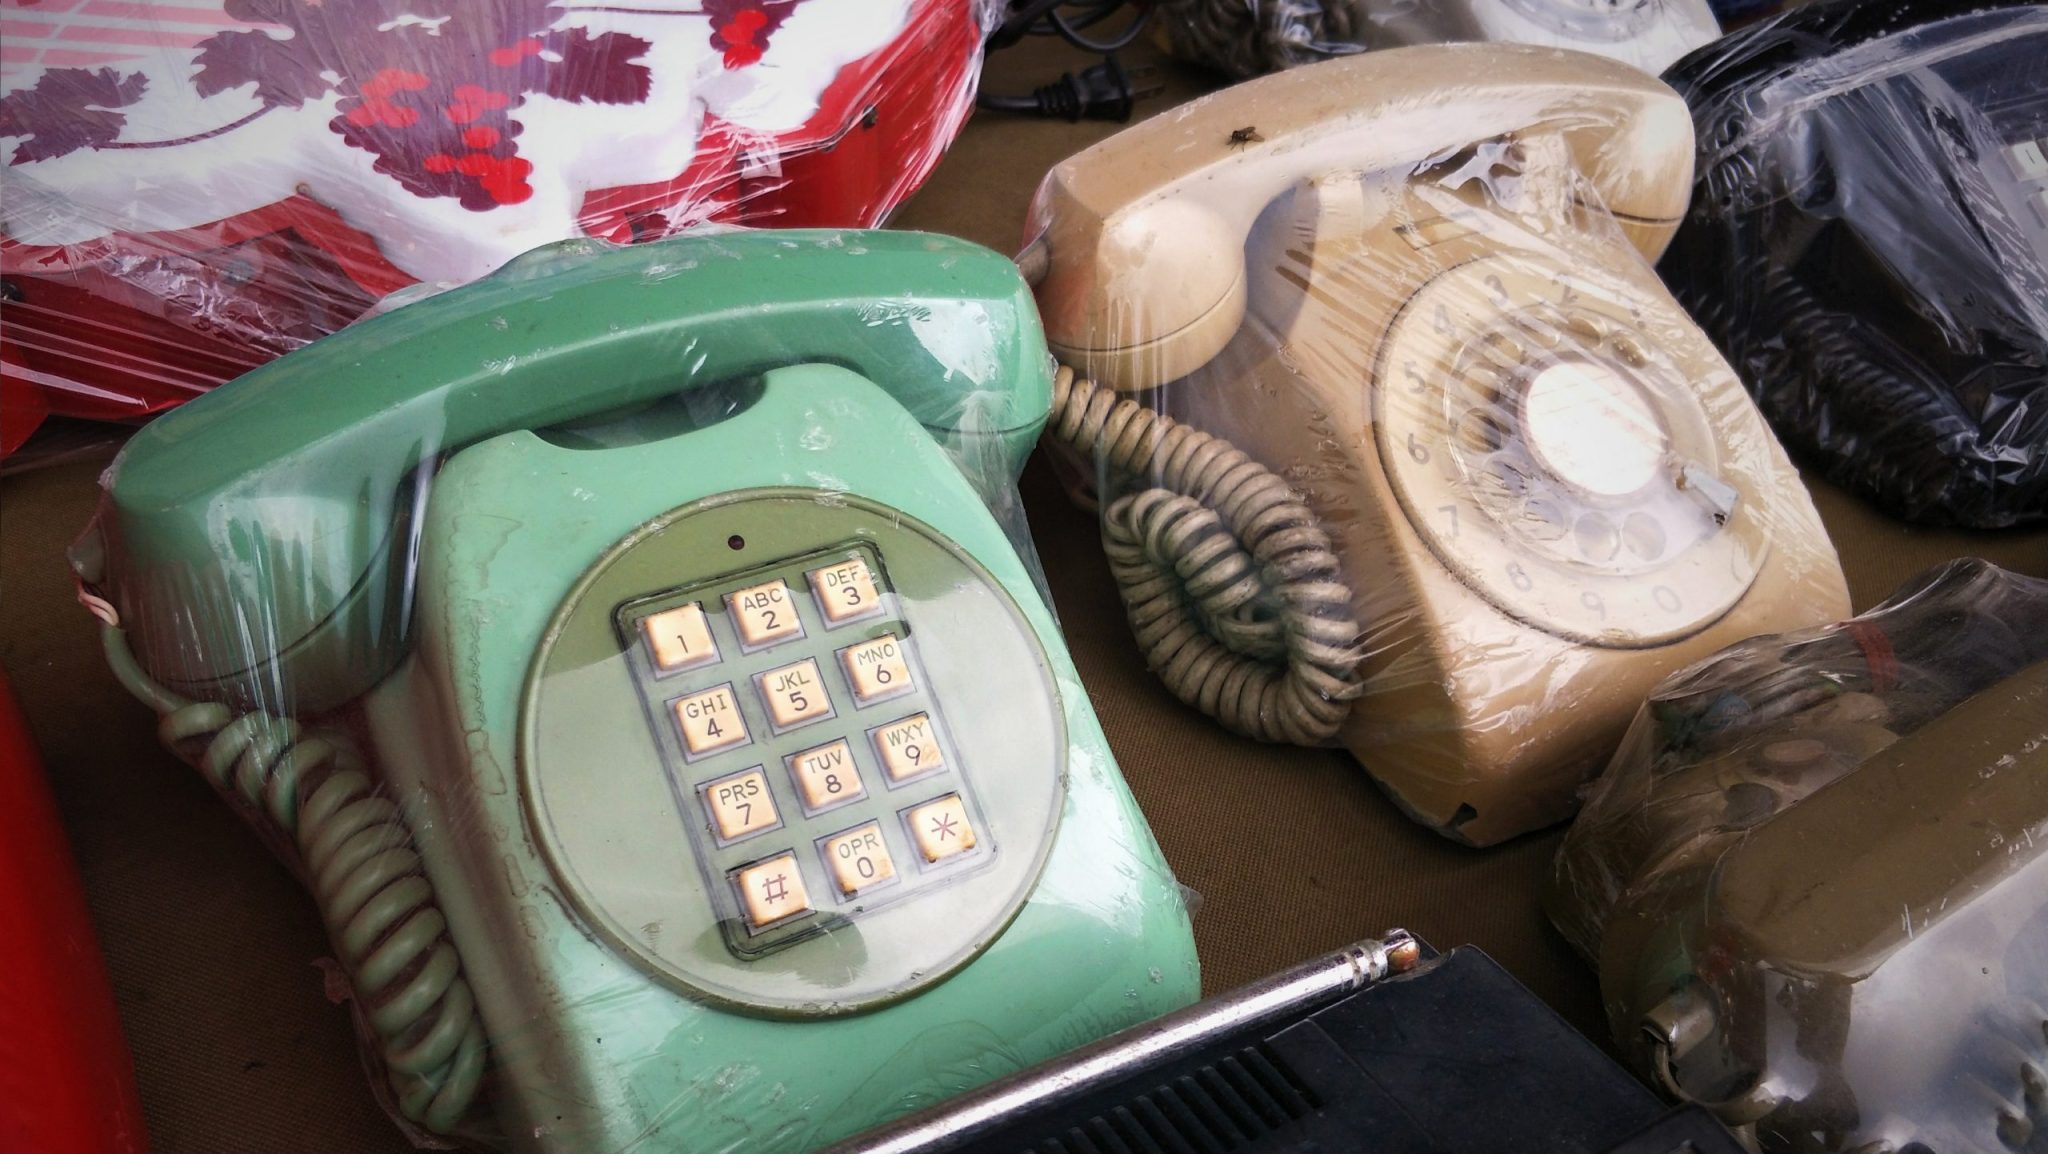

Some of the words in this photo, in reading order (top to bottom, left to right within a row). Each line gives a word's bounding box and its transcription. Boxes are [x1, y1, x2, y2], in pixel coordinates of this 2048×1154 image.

[1404, 361, 1425, 394] 5
[1408, 433, 1431, 464] 6
[1437, 505, 1460, 537] 7
[826, 565, 860, 587] DEF
[1505, 561, 1533, 592] 8
[743, 588, 784, 611] ABC
[842, 586, 861, 606] 3
[1580, 590, 1606, 621] 9
[761, 610, 780, 630] 2
[677, 634, 689, 653] 1
[857, 643, 895, 666] MNO
[775, 670, 811, 692] JKL
[876, 664, 892, 684] 6
[686, 694, 728, 718] GHI
[789, 691, 808, 711] 5
[707, 718, 723, 738] 4
[886, 722, 924, 747] WXY
[805, 749, 842, 774] TUV
[905, 745, 921, 766] 9
[719, 779, 759, 806] PRS
[825, 774, 842, 794] 8
[736, 803, 751, 825] 7
[838, 832, 880, 859] OPR
[856, 856, 875, 879] 0
